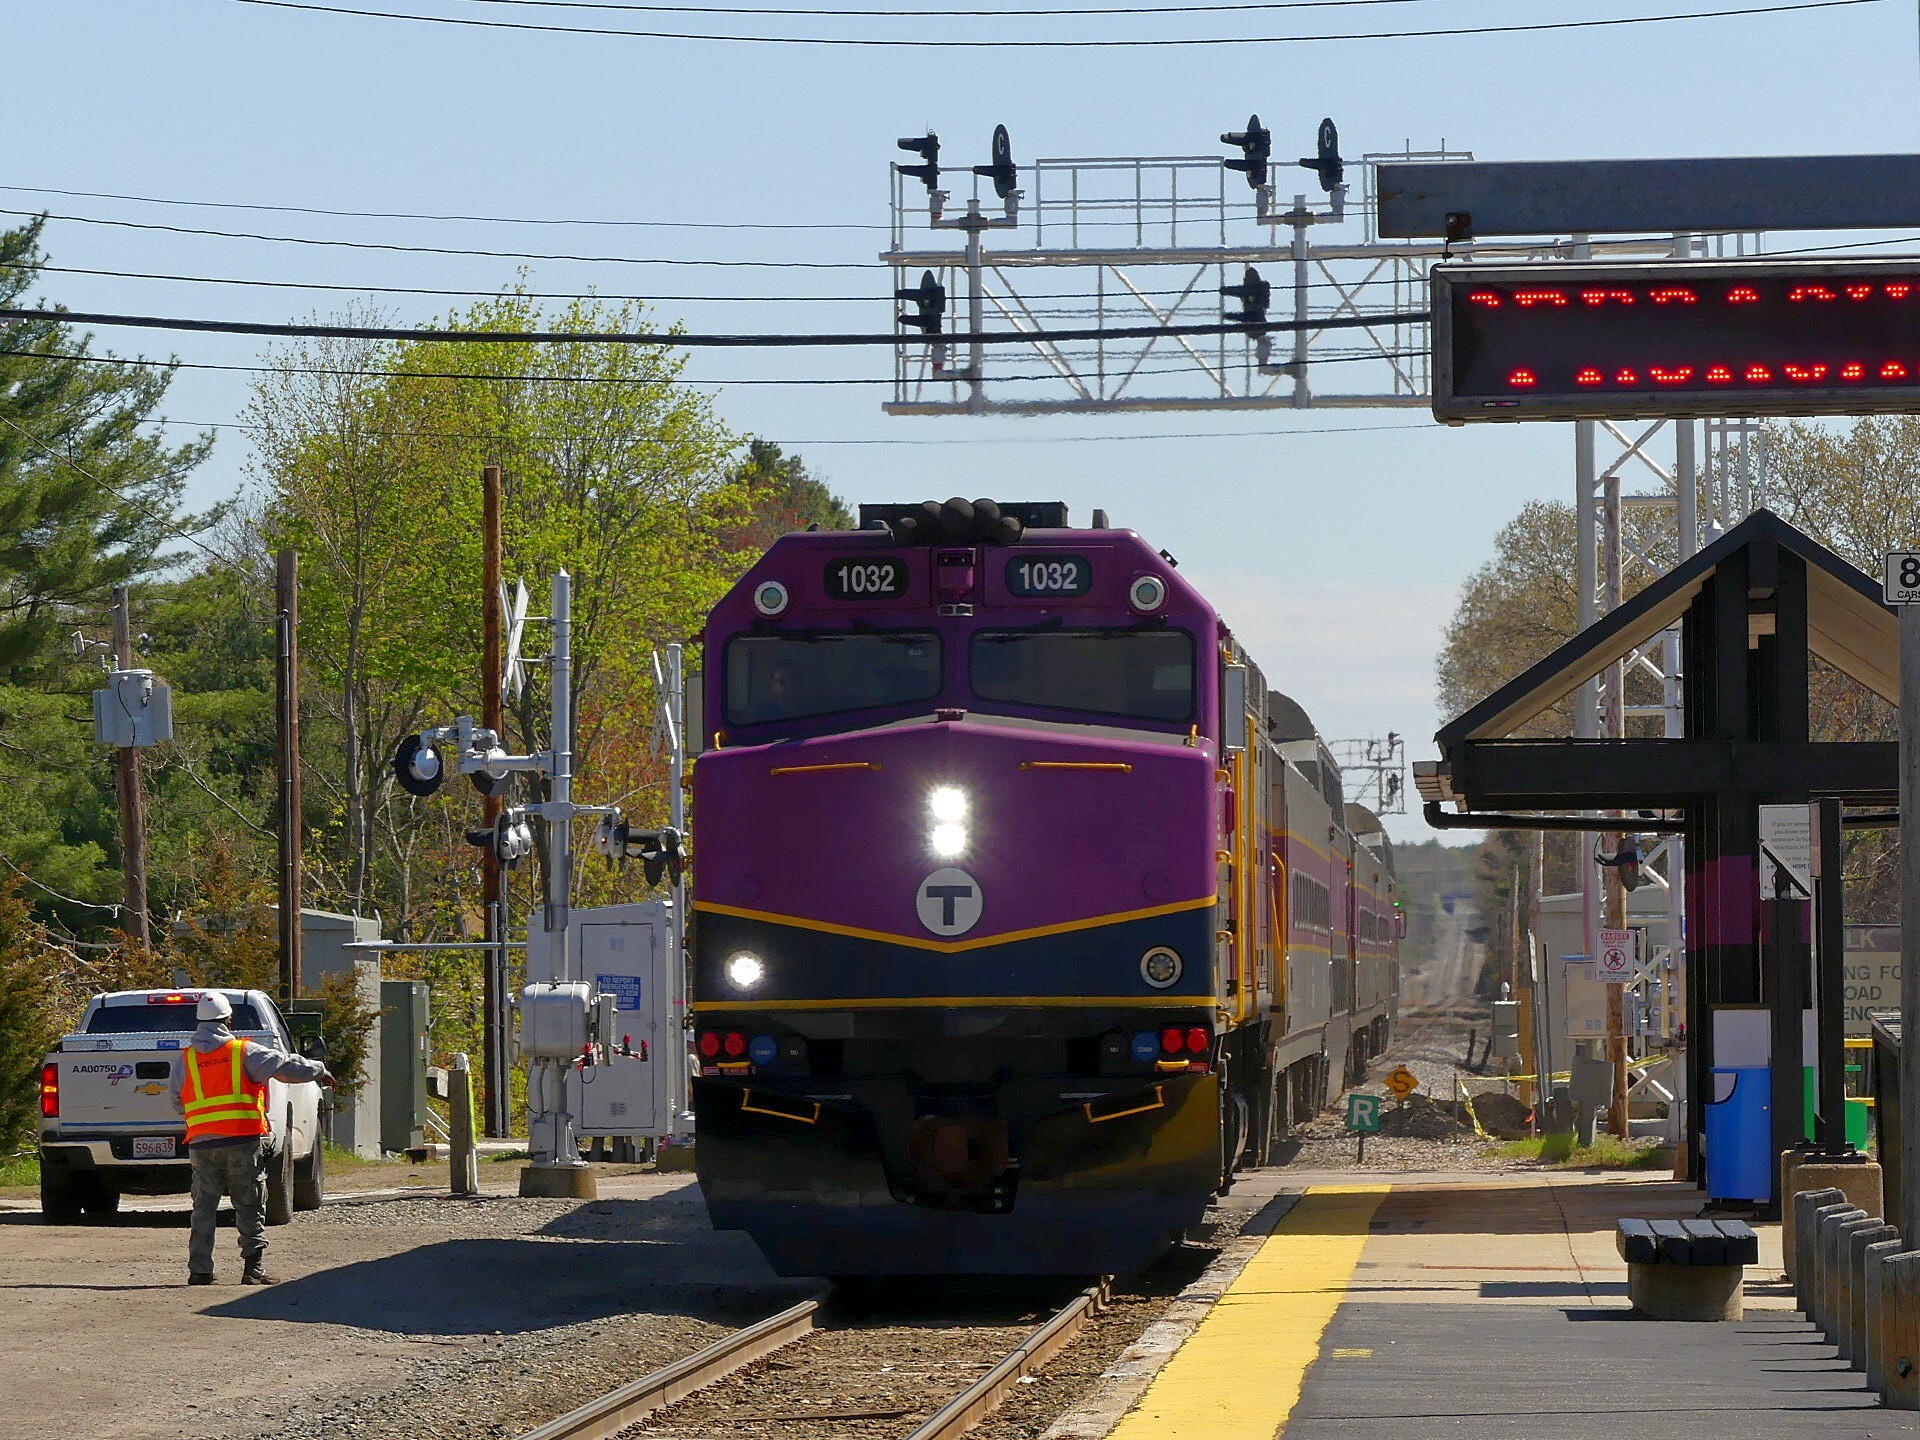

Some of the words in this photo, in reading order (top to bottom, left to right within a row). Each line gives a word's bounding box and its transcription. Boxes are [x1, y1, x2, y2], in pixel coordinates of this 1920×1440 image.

[998, 133, 1005, 155] C
[838, 565, 895, 592] 1032
[1019, 562, 1078, 590] 1032
[1900, 557, 1920, 588] 8
[926, 886, 973, 926] T
[72, 1064, 117, 1073] AA00750
[1393, 1071, 1410, 1092] S
[1352, 1099, 1373, 1126] R
